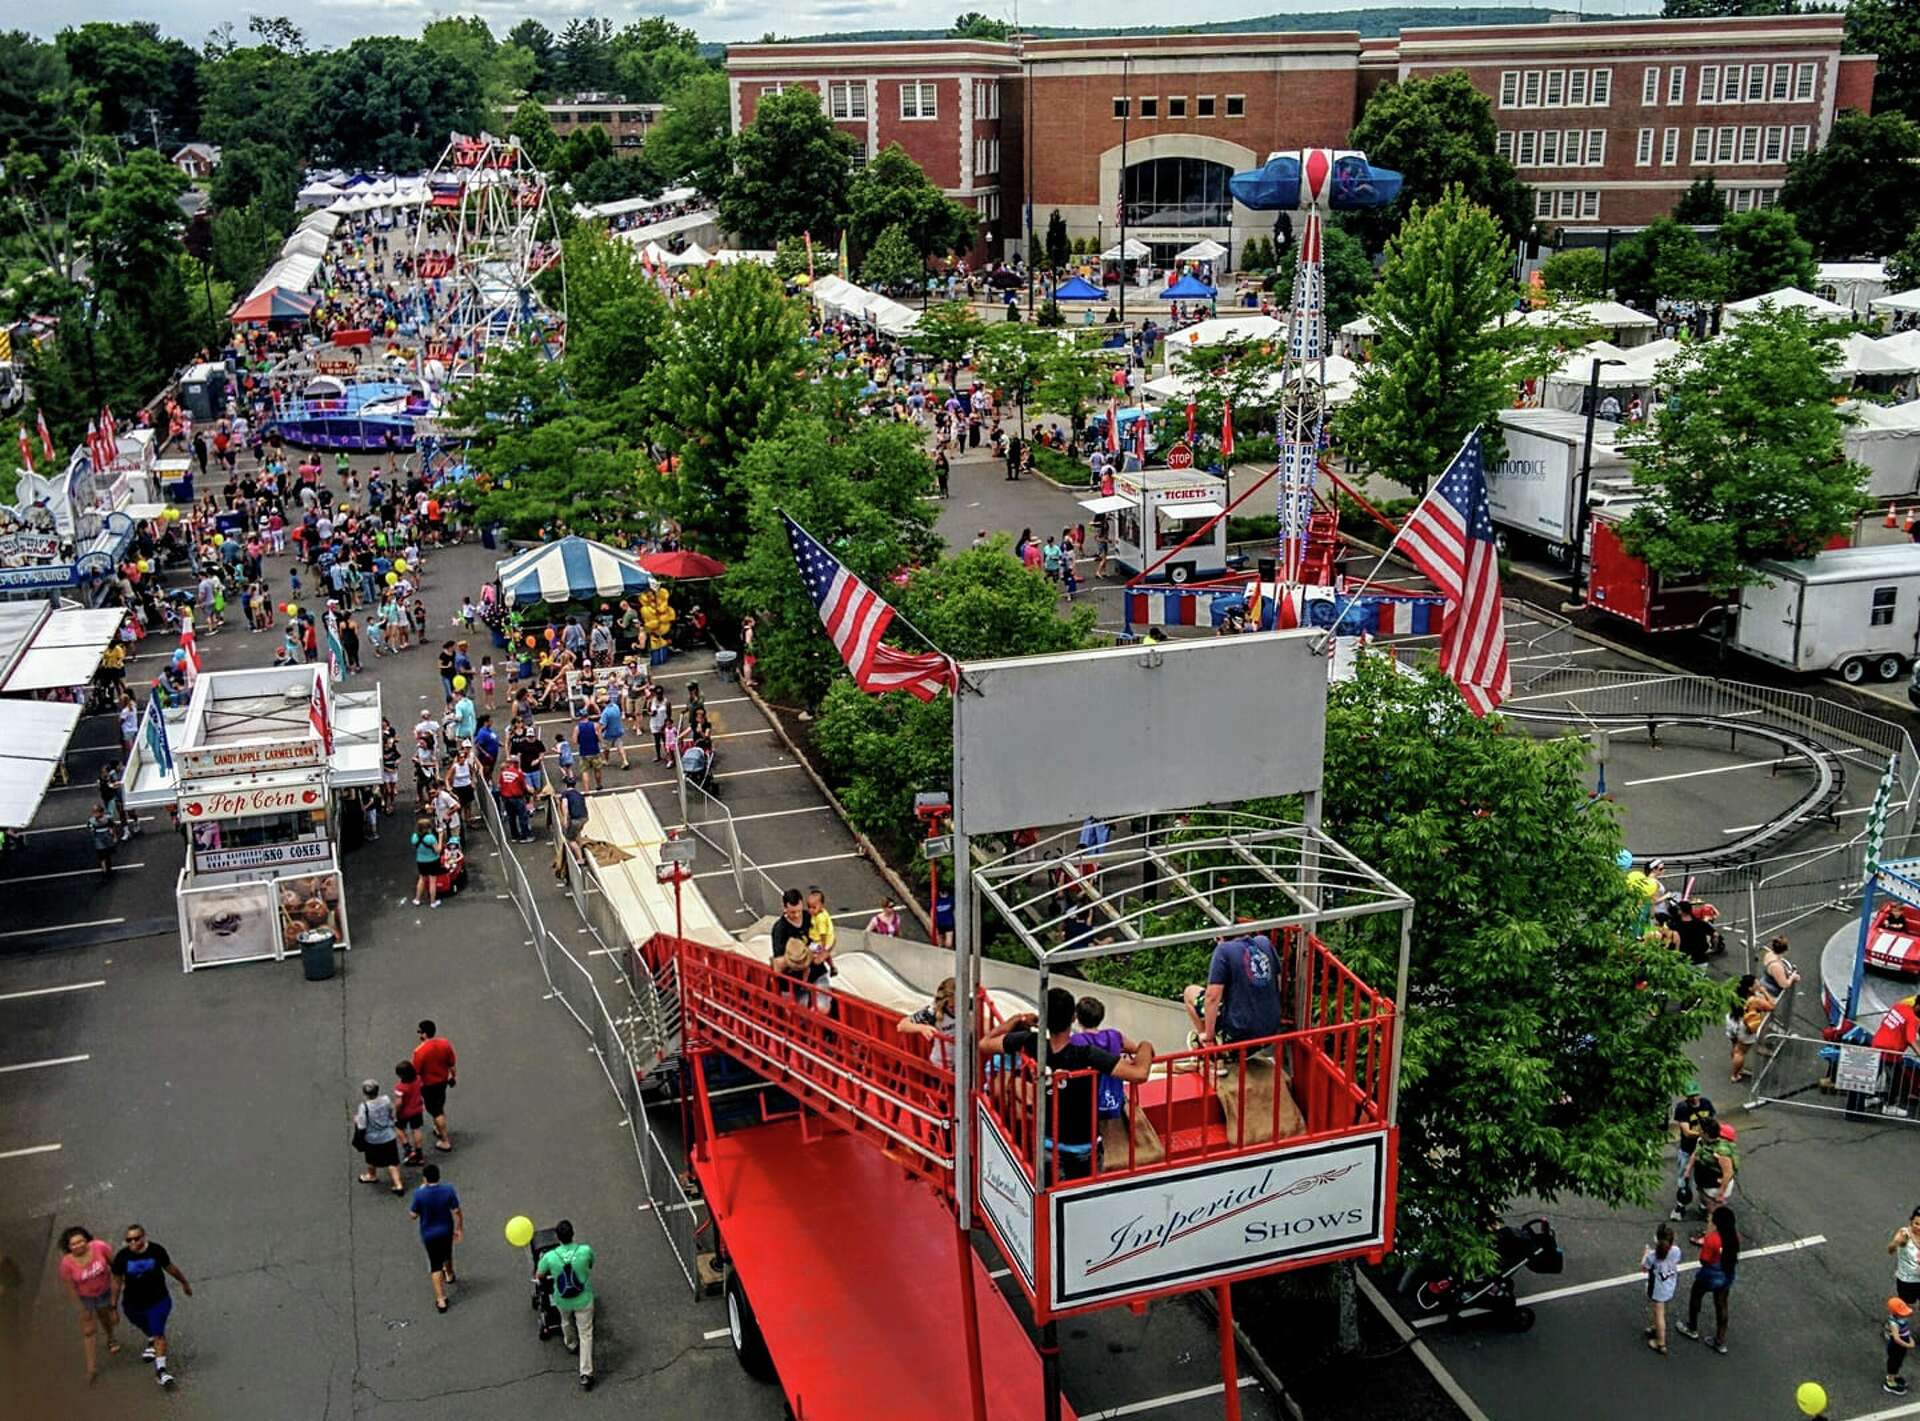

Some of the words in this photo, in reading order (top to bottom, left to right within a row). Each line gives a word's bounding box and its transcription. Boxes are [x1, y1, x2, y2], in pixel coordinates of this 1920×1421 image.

[1169, 453, 1191, 464] STOP
[1164, 489, 1207, 500] TICKETS
[214, 753, 236, 766] CANDY
[238, 752, 260, 763] APPLE
[294, 746, 314, 758] CORN
[208, 794, 246, 815] Pop
[252, 790, 295, 809] Corn
[265, 848, 283, 861] SNO
[290, 844, 321, 858] CONES
[1086, 1168, 1274, 1266] Imperial
[1244, 1208, 1363, 1244] SHOWS
